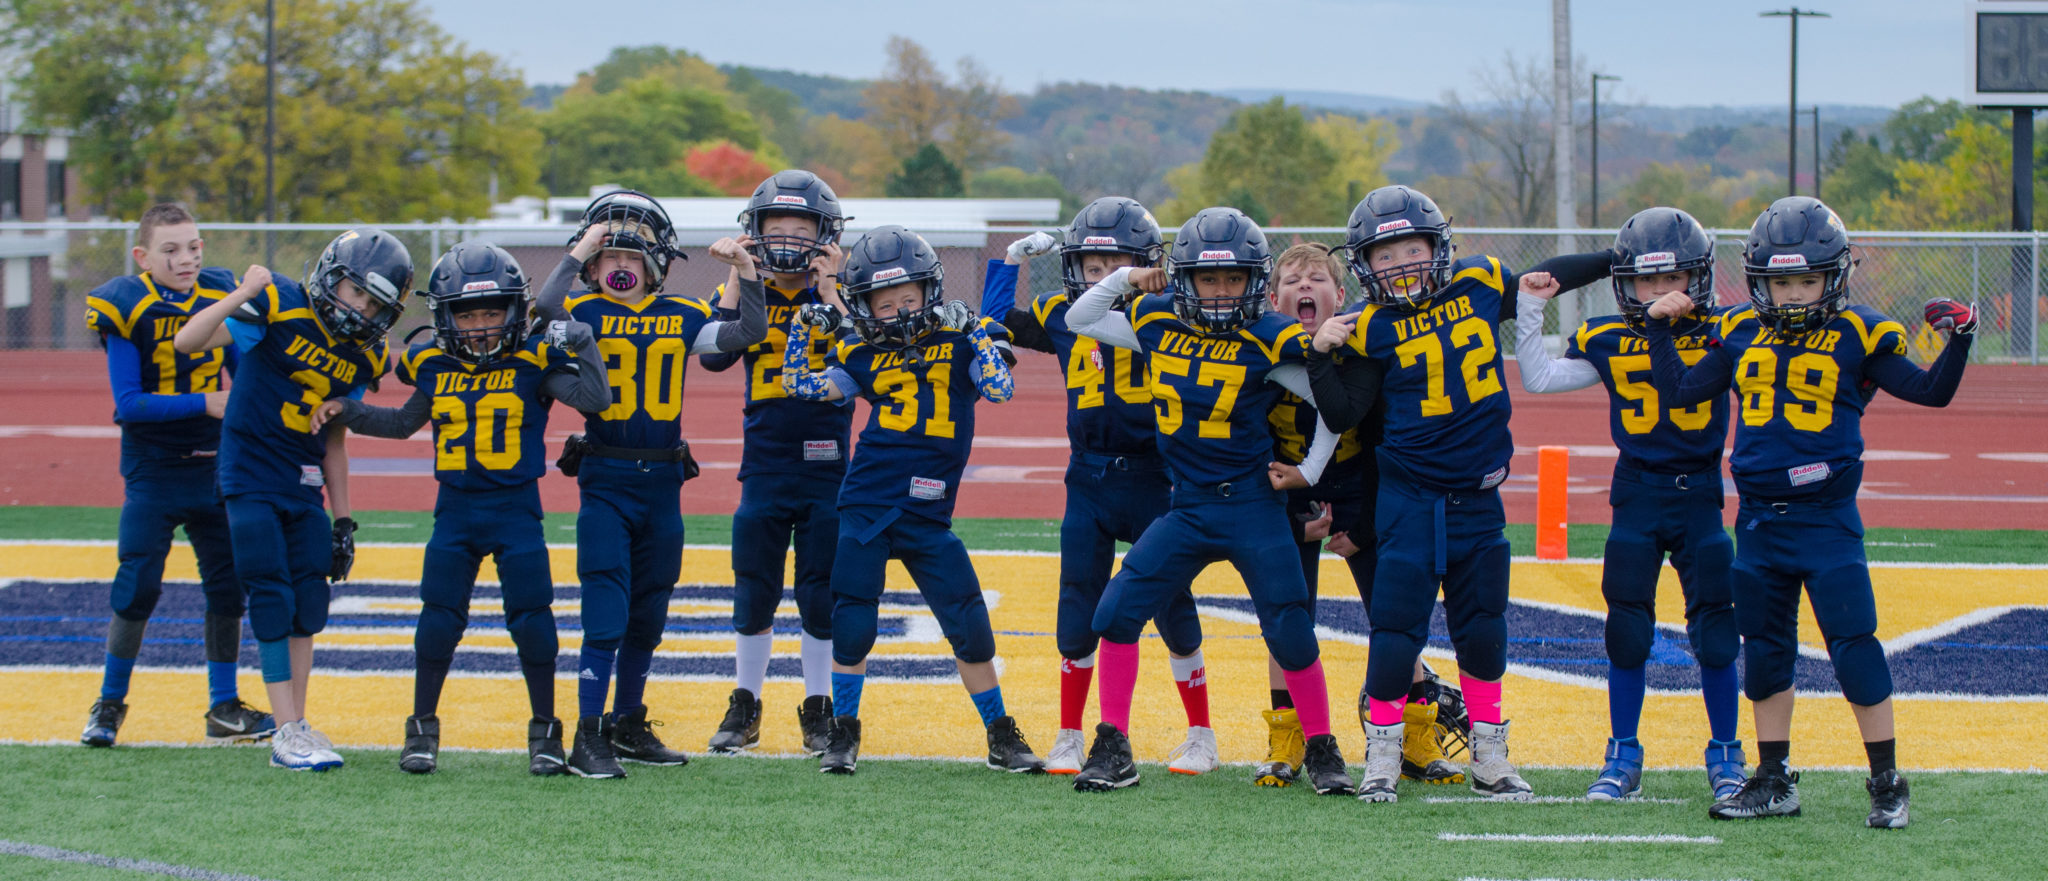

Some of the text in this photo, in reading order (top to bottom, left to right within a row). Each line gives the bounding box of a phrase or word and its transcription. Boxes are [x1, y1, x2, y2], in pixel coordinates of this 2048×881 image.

[1379, 221, 1407, 232] Riddell
[875, 269, 903, 280] Riddell
[601, 315, 683, 335] VICTOR
[1392, 295, 1474, 341] VICTOR
[285, 334, 357, 384] VICTOR
[1158, 330, 1242, 361] VICTOR
[1395, 316, 1503, 418] 72
[434, 368, 517, 395] VICTOR
[597, 338, 686, 421] 30
[1067, 334, 1153, 410] 40
[1151, 351, 1247, 438] 57
[1735, 347, 1840, 432] 89
[281, 369, 331, 433] 3
[872, 363, 955, 439] 31
[431, 392, 524, 471] 20
[914, 479, 942, 489] Riddell
[1792, 463, 1823, 476] Riddell
